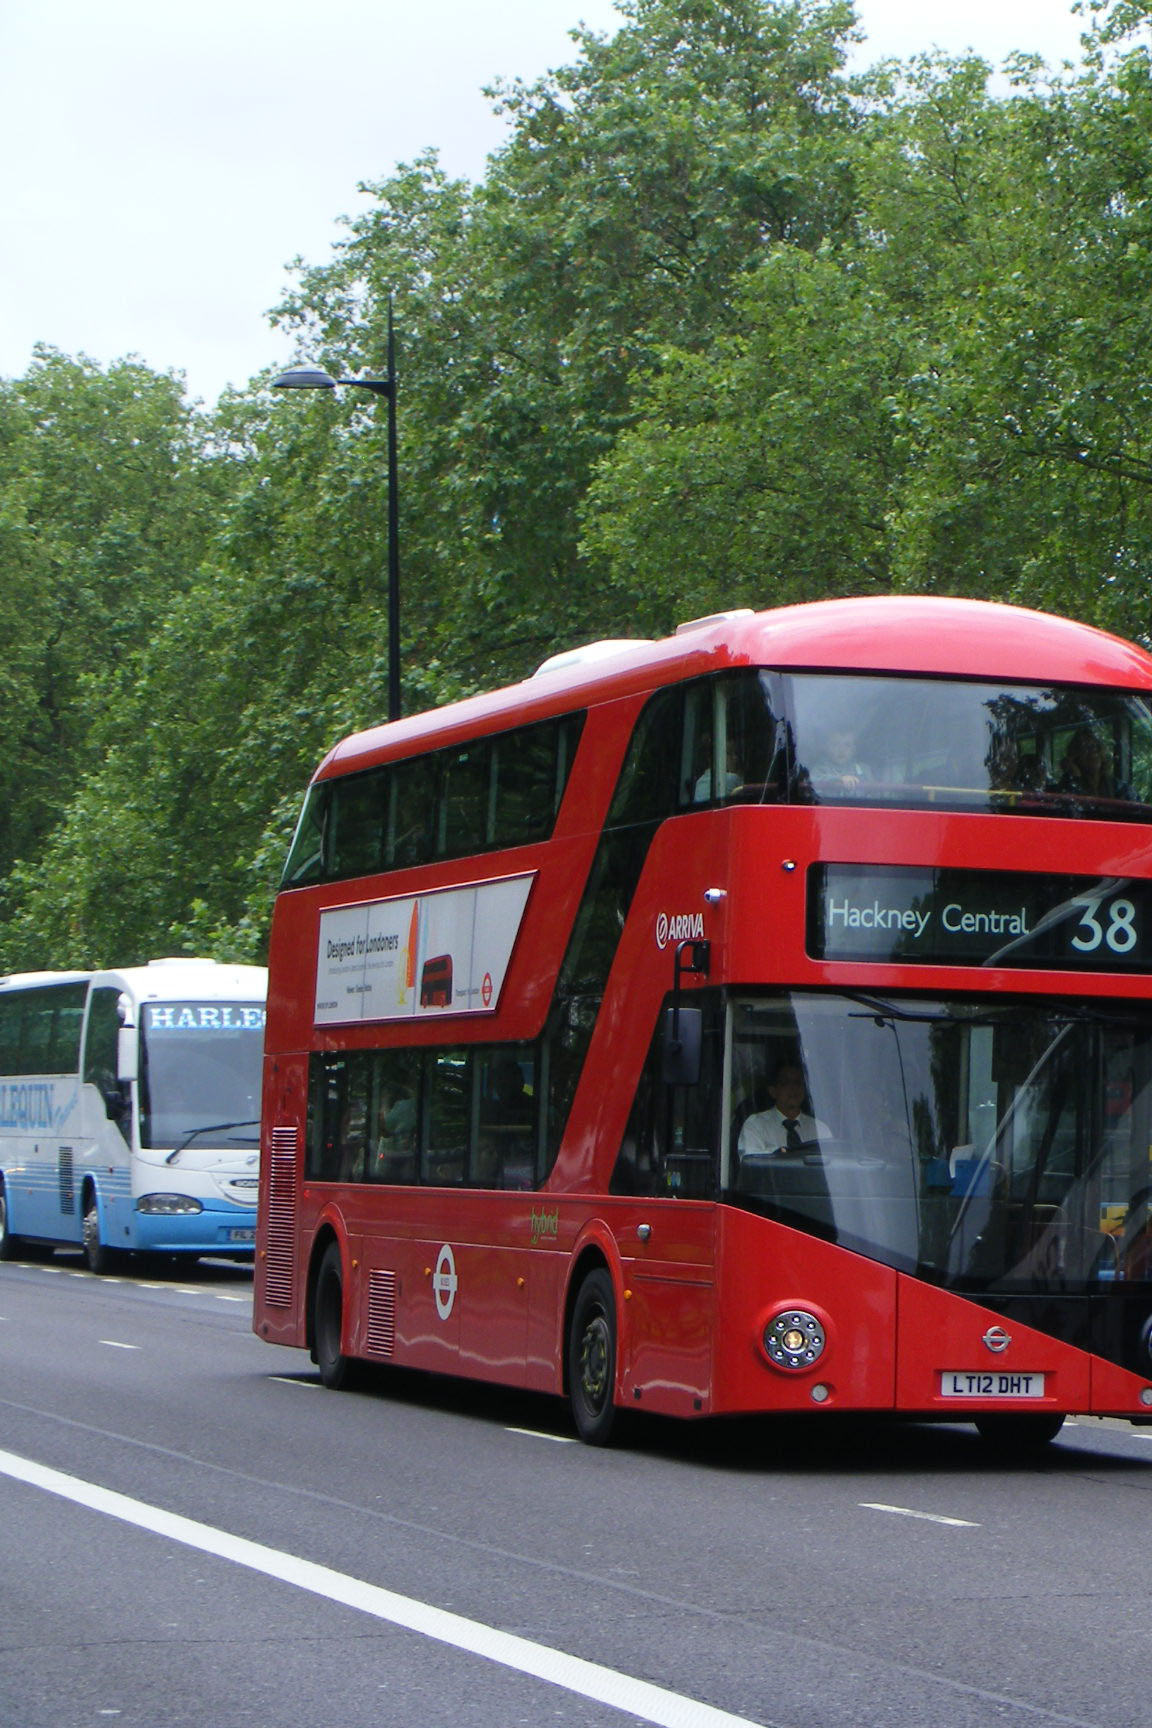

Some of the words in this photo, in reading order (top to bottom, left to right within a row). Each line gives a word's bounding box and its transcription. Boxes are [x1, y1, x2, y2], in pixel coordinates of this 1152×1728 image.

[668, 913, 704, 940] ARRIVA
[828, 898, 931, 938] Hackney
[942, 904, 1030, 935] Central
[1071, 899, 1138, 954] 38
[327, 936, 355, 962] Designed
[356, 935, 366, 954] for
[366, 931, 399, 953] Londoners
[150, 1007, 266, 1029] HARLE
[531, 1206, 559, 1245] hybrid
[953, 1376, 993, 1393] LT12
[998, 1376, 1033, 1394] DHT
